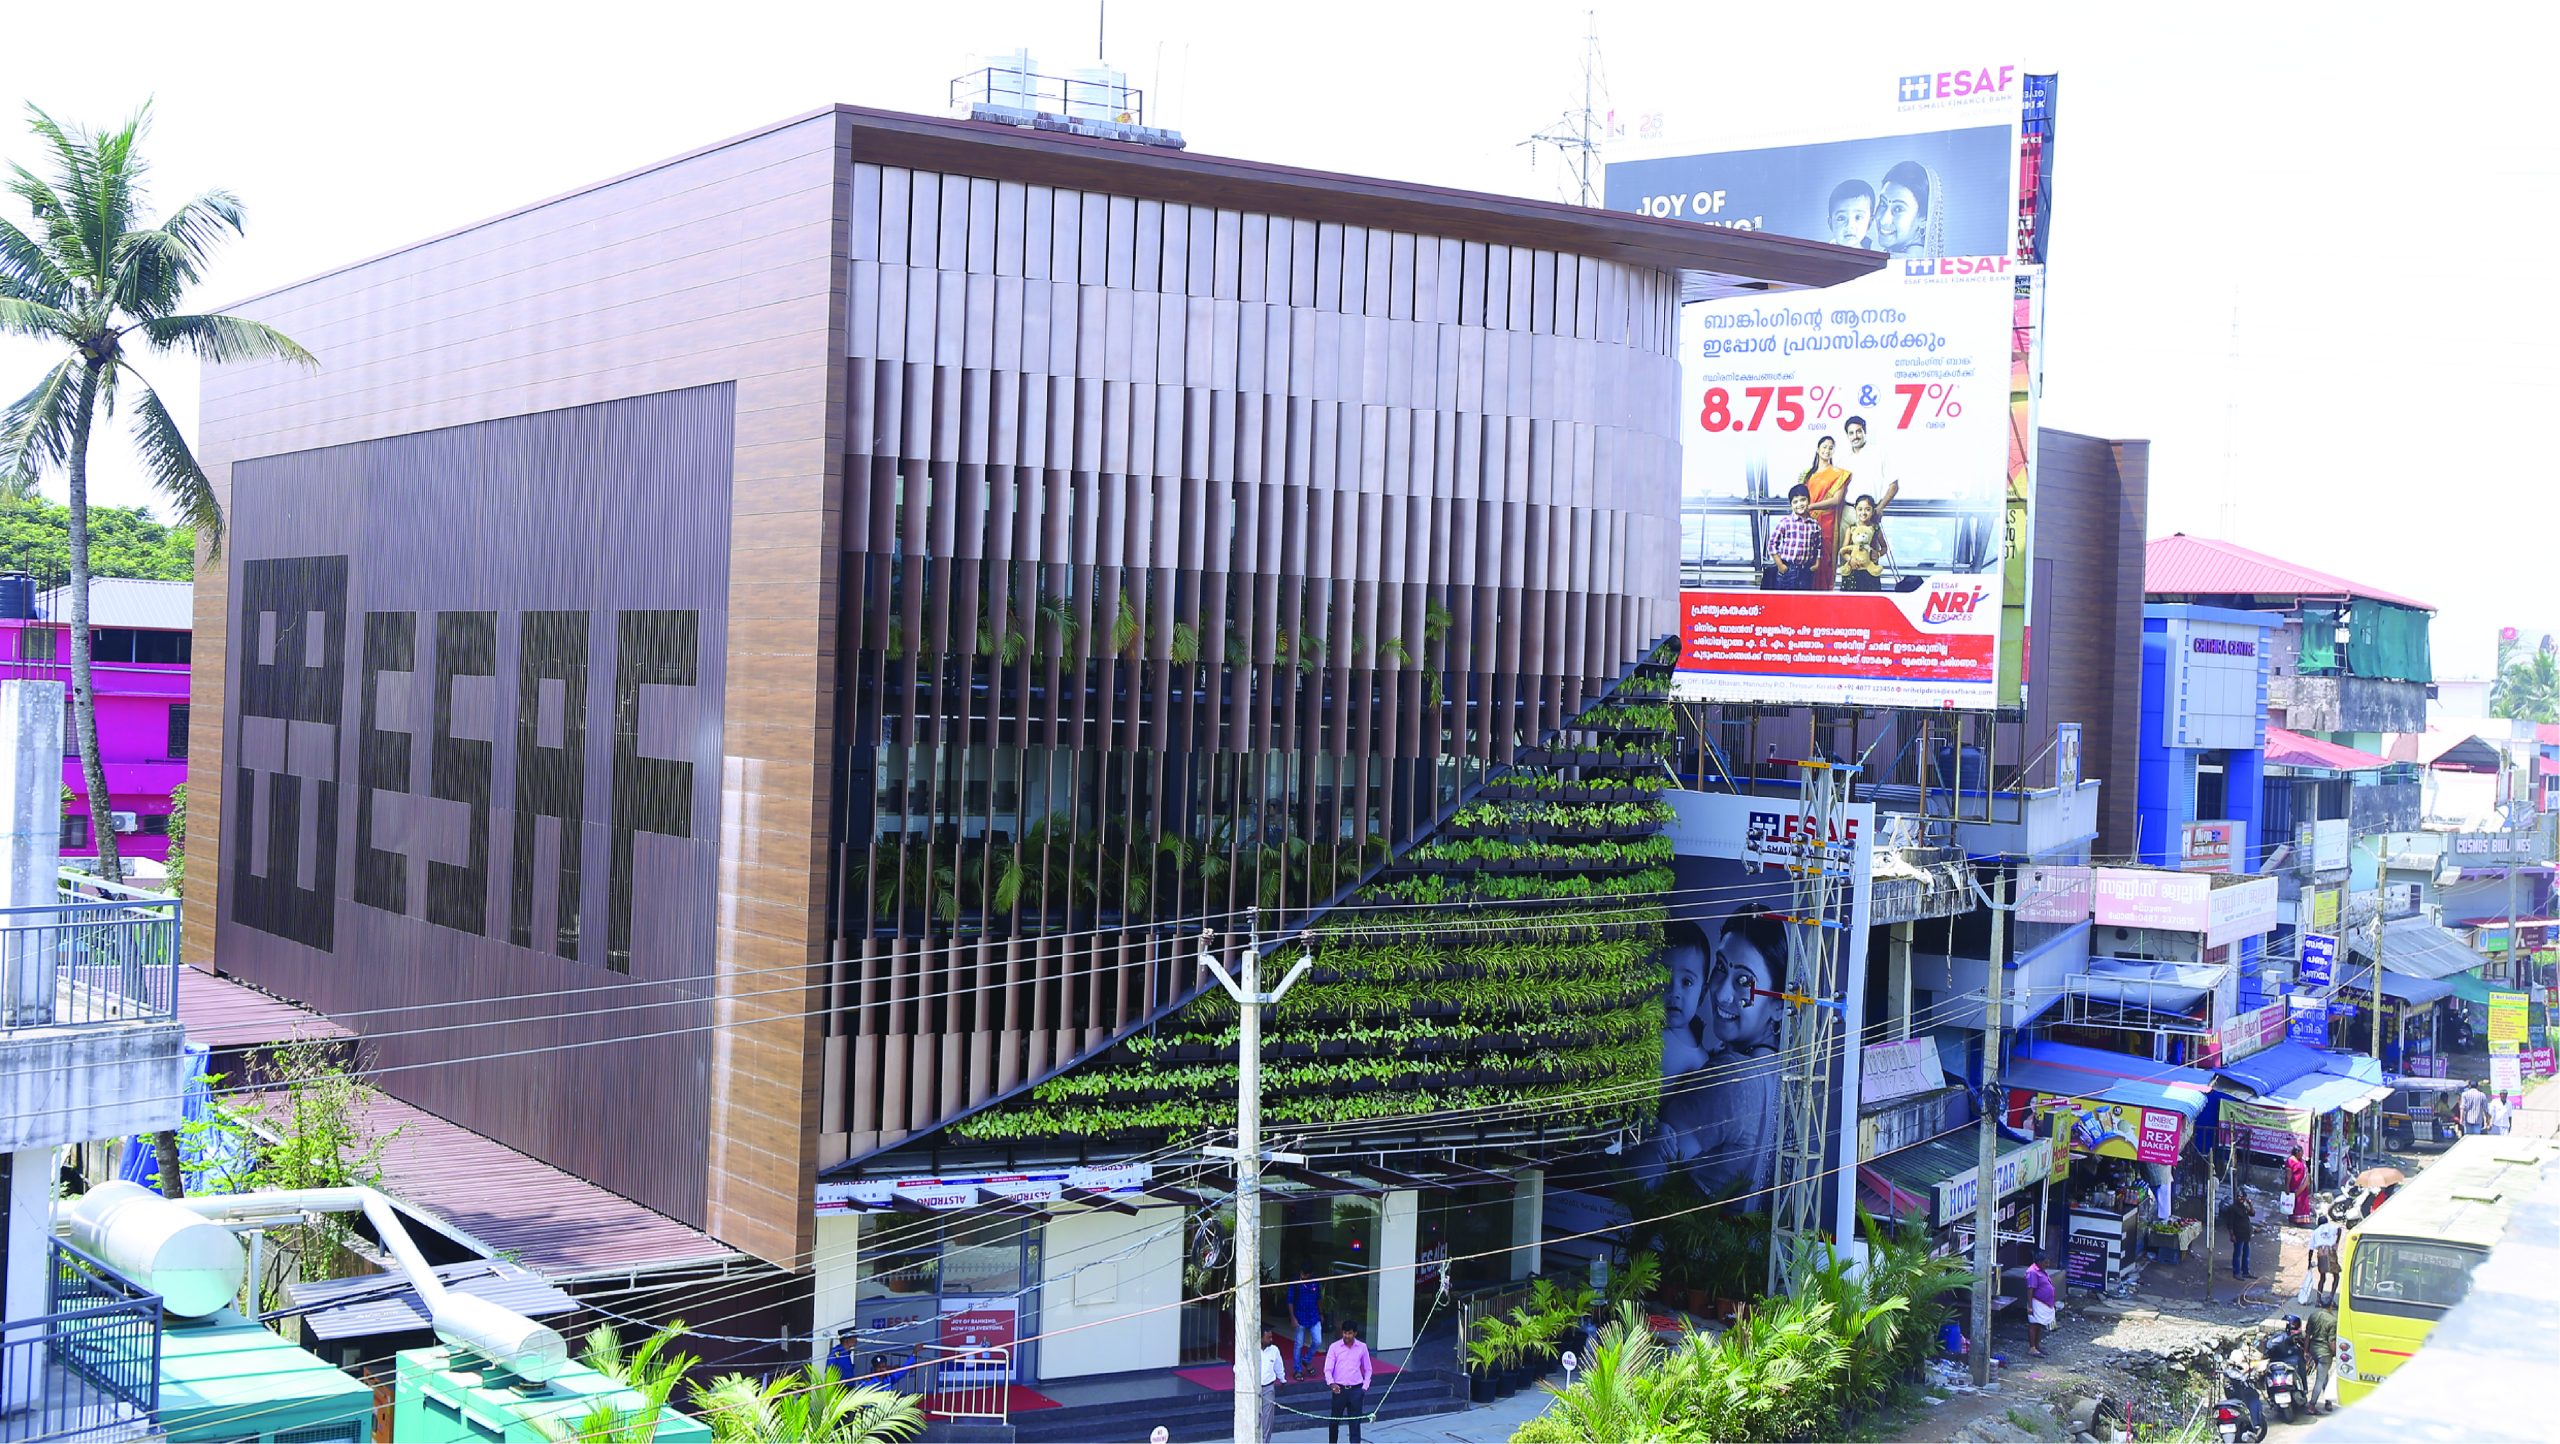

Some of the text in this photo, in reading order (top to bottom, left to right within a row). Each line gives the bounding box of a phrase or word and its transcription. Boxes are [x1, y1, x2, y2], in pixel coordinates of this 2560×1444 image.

[1936, 65, 2014, 99] ESAF
[1636, 190, 1726, 218] JOY OF
[1940, 256, 2012, 275] ESAF
[1924, 277, 1948, 285] SMALL
[1951, 276, 1987, 284] FINANCE
[1831, 308, 1906, 328] ആനന്ദം
[1703, 330, 1945, 358] ഇപ്പോൾ പ്രവാസികൾക്കും
[1859, 384, 1877, 406] &
[1931, 613, 1973, 621] SERVICES
[2457, 838, 2531, 854] COSMOS BUILNGS
[2141, 1140, 2176, 1152] BAKERY
[2146, 1131, 2173, 1144] REX
[1949, 1178, 1978, 1217] HOTE
